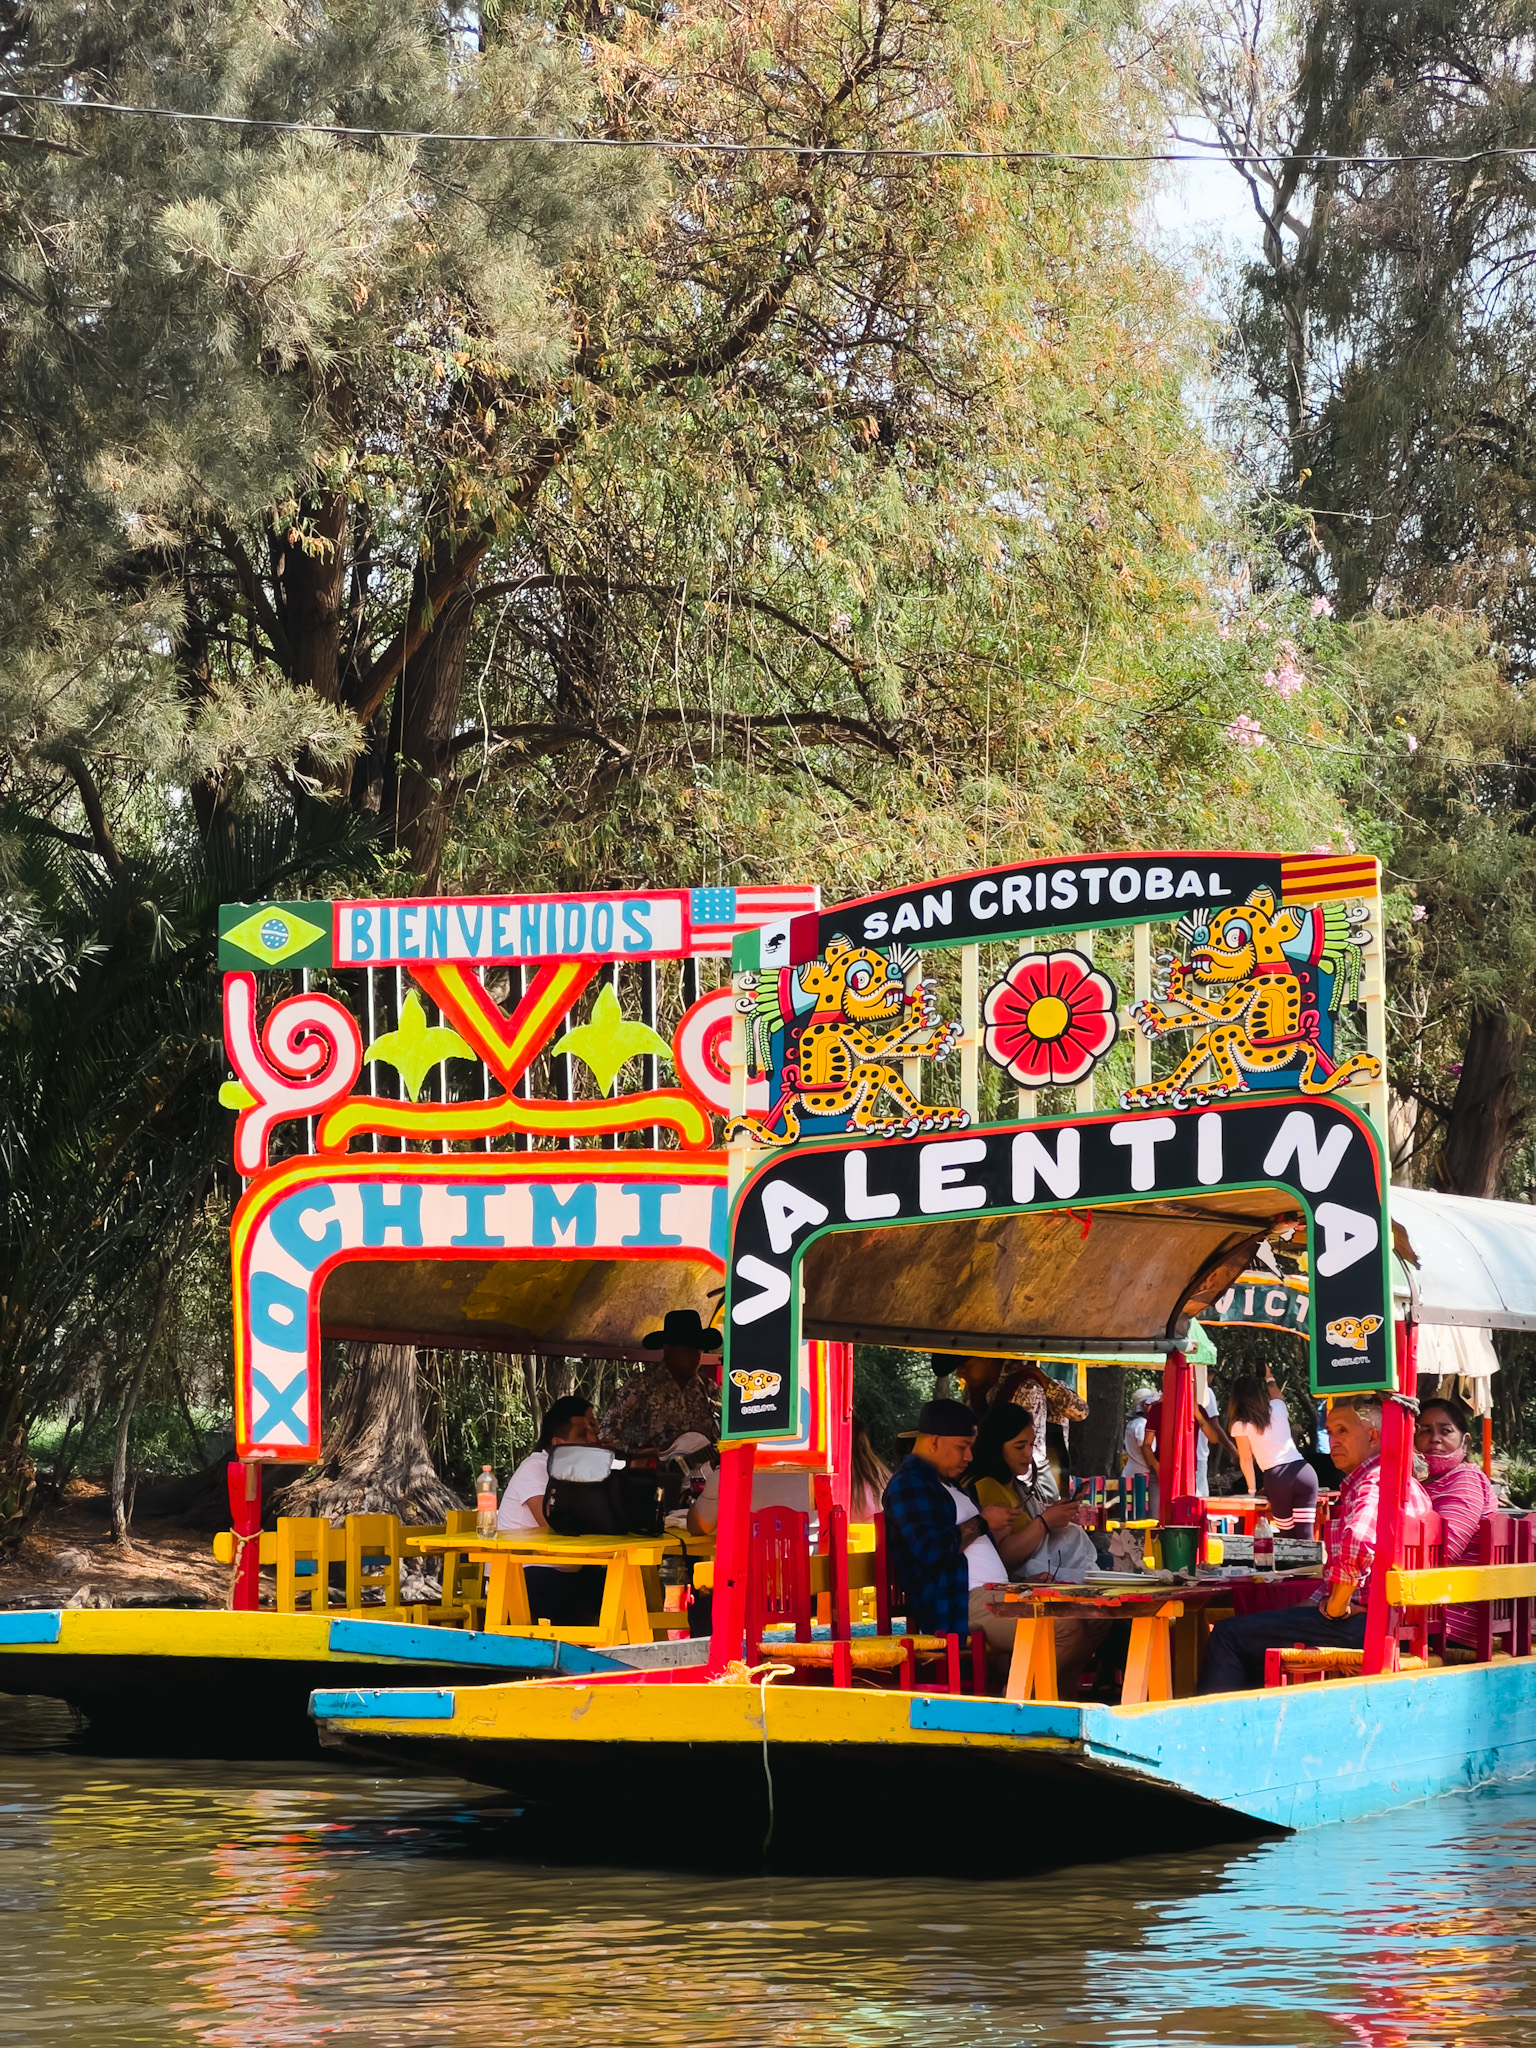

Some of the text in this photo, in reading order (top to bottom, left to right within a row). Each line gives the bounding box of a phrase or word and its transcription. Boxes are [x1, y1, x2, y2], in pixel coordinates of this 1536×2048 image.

[350, 901, 653, 961] BIENVENIDOS
[863, 866, 1232, 939] SAN CRISTOBAL
[732, 1110, 1379, 1326] VALENTINA
[251, 1183, 809, 1445] XOCHIMI
